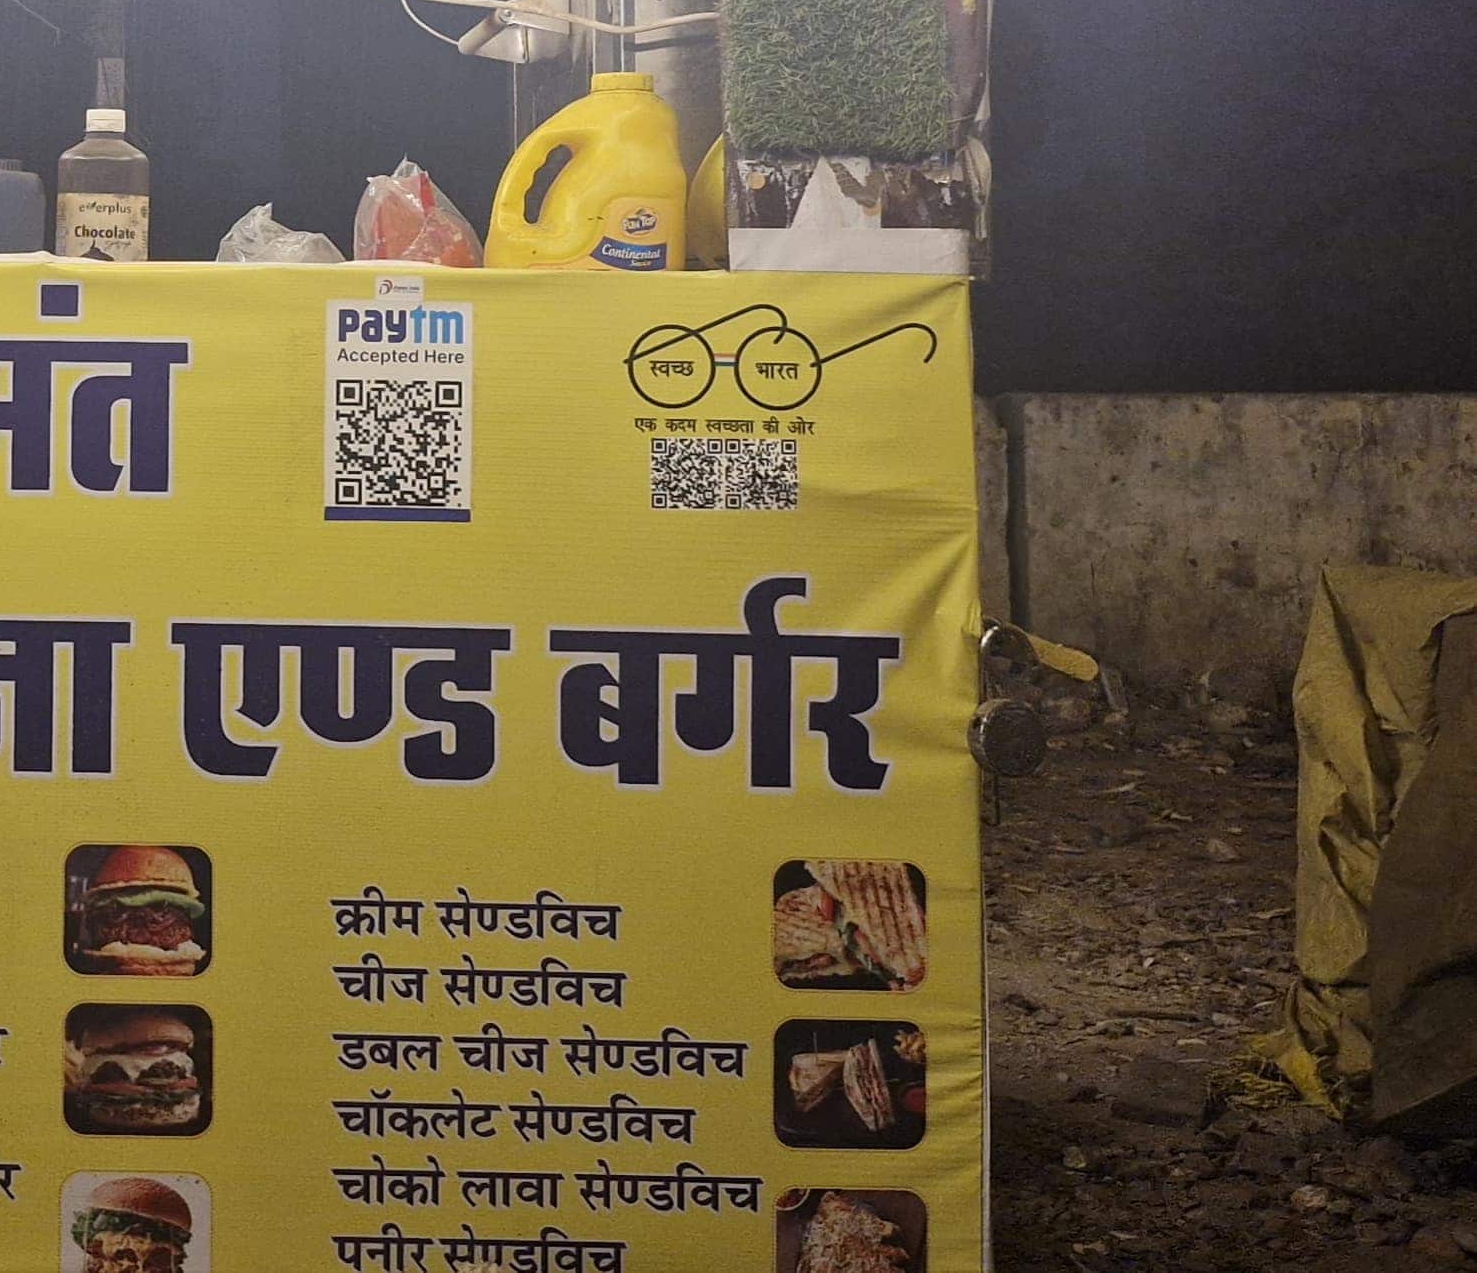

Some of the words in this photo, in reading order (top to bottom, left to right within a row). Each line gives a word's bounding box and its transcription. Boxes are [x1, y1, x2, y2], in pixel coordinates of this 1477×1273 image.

[74, 224, 136, 239] Chocolate
[602, 243, 661, 259] Continental
[337, 307, 465, 345] paytm
[336, 347, 419, 366] Accepted
[424, 349, 465, 364] Here
[649, 360, 695, 378] स्वच्छ
[755, 362, 800, 380] भारत
[634, 417, 658, 433] एक
[664, 418, 698, 433] कदम
[705, 419, 755, 434] स्वच्छता
[761, 415, 780, 434] की
[787, 415, 816, 435] ओर
[171, 622, 511, 781] एण्ड
[549, 577, 901, 791] बर्गर
[329, 885, 425, 936] क्रीम
[434, 887, 622, 941] सेण्डविच
[332, 952, 429, 1003] चीज
[439, 954, 628, 1008] सेण्डविच
[332, 1033, 443, 1071] डबल
[452, 1022, 550, 1073] चीज
[559, 1024, 749, 1078] सेण्डविच
[331, 1088, 503, 1139] चॉकलेट
[508, 1090, 697, 1144] सेण्डविच
[331, 1154, 446, 1206] चोको
[456, 1171, 565, 1209] लावा
[574, 1159, 764, 1213] सेण्डविच
[331, 1222, 435, 1273] पनीर
